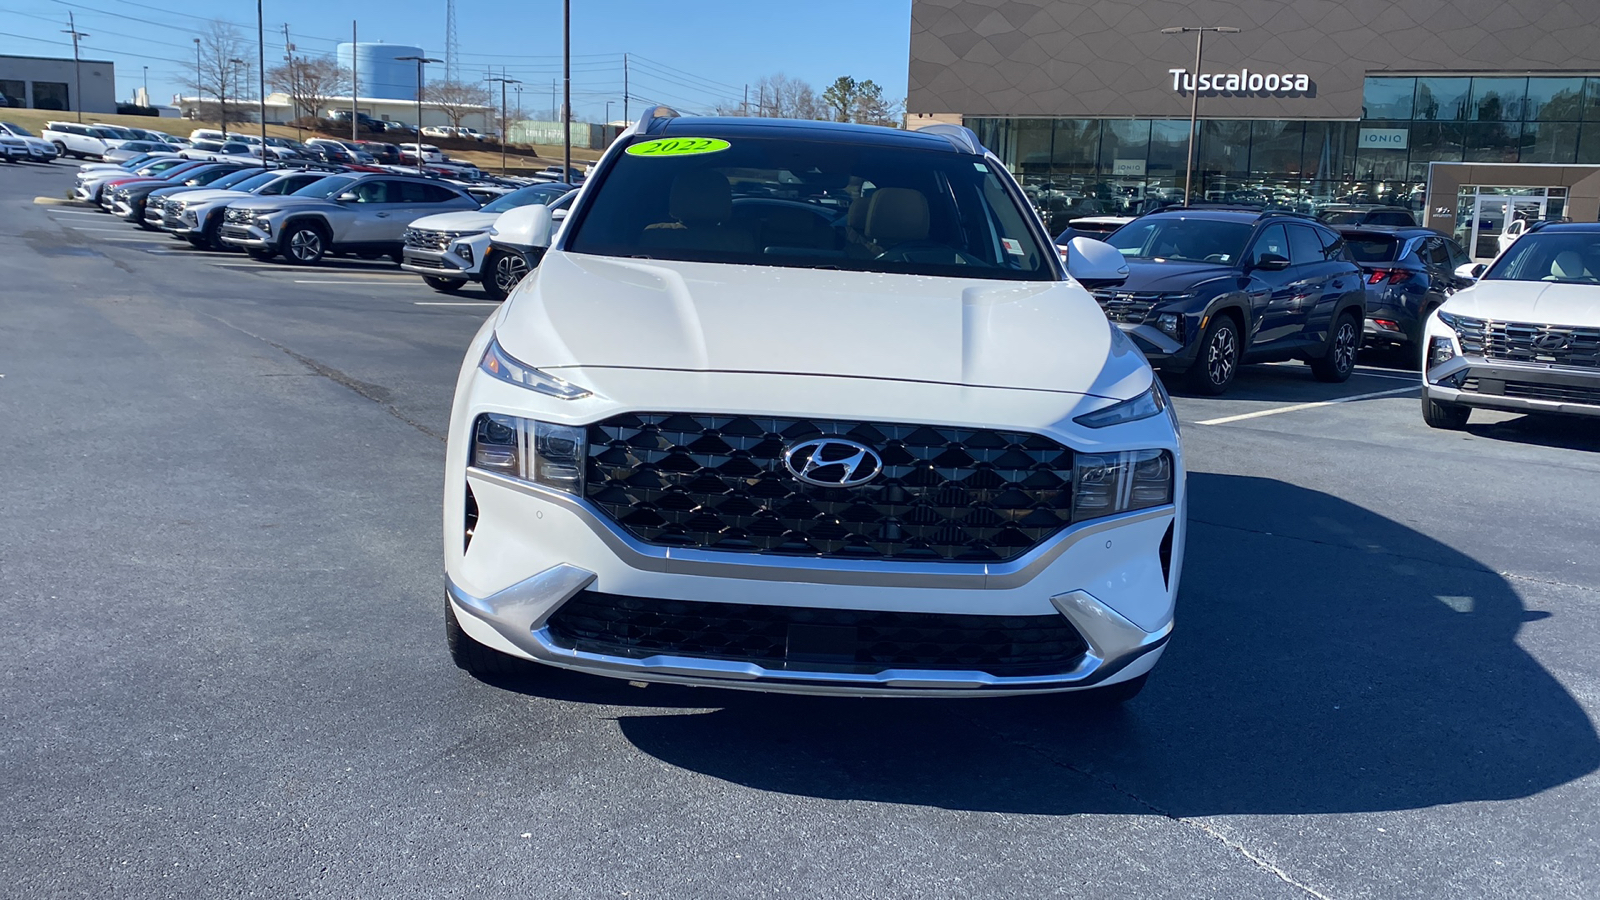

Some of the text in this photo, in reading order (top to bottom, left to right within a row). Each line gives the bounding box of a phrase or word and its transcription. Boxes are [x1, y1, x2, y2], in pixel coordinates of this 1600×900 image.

[1168, 68, 1310, 92] Tuscaloosa
[1364, 134, 1402, 143] IONIQ
[642, 140, 713, 154] 2022
